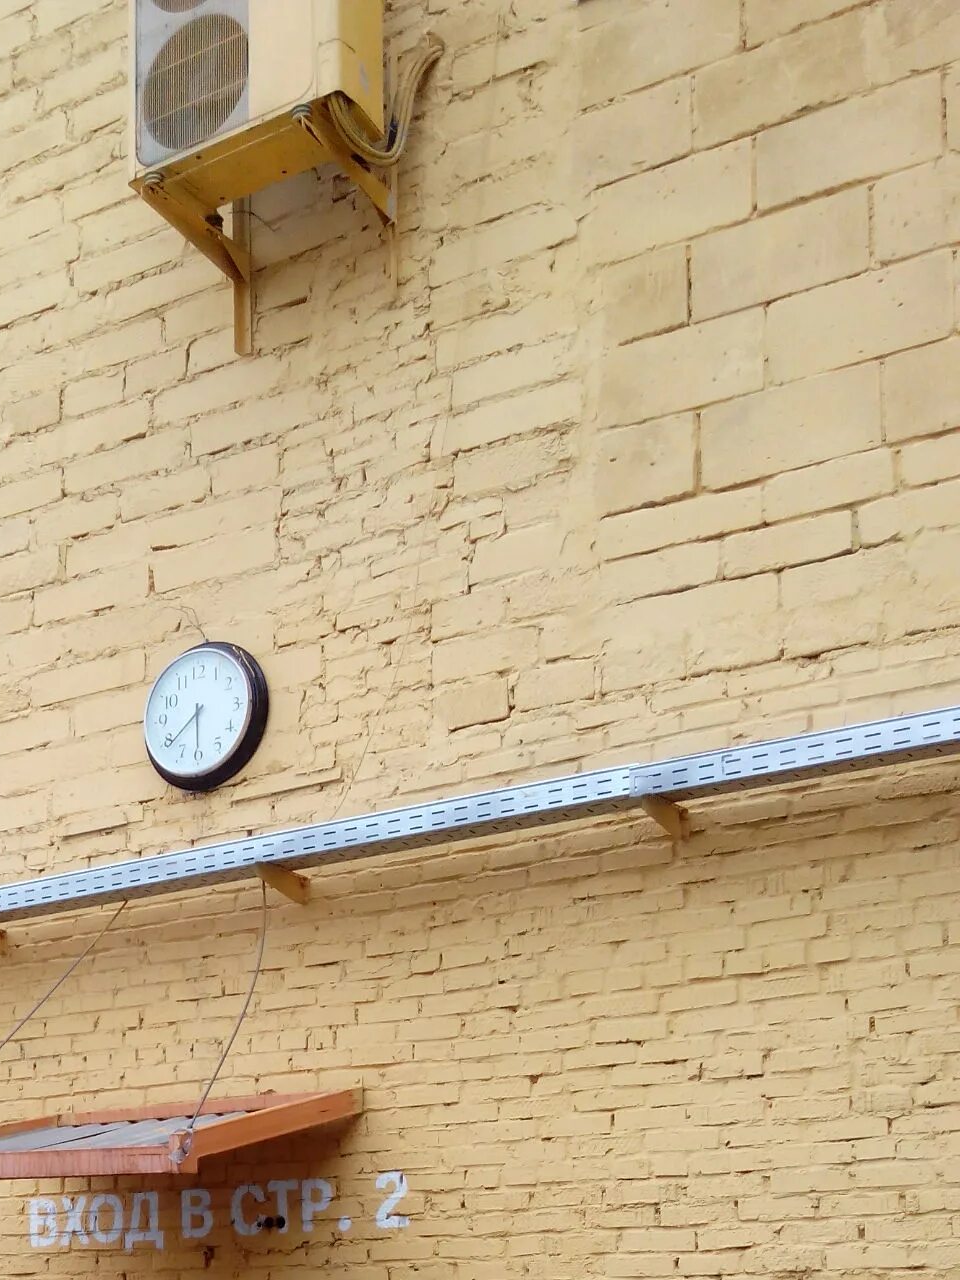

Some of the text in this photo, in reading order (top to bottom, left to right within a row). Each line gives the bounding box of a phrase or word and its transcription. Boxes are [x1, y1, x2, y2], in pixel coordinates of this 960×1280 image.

[192, 665, 205, 680] 12
[177, 675, 187, 690] 11
[224, 676, 233, 691] 2
[165, 694, 178, 709] 10
[232, 697, 240, 711] 3
[158, 714, 168, 728] 9
[225, 719, 234, 732] 4
[164, 733, 174, 747] 8
[214, 737, 222, 753] 5
[178, 744, 186, 758] 7
[193, 747, 203, 761] 6
[28, 1171, 411, 1251] ВХОД В СТР. 2
